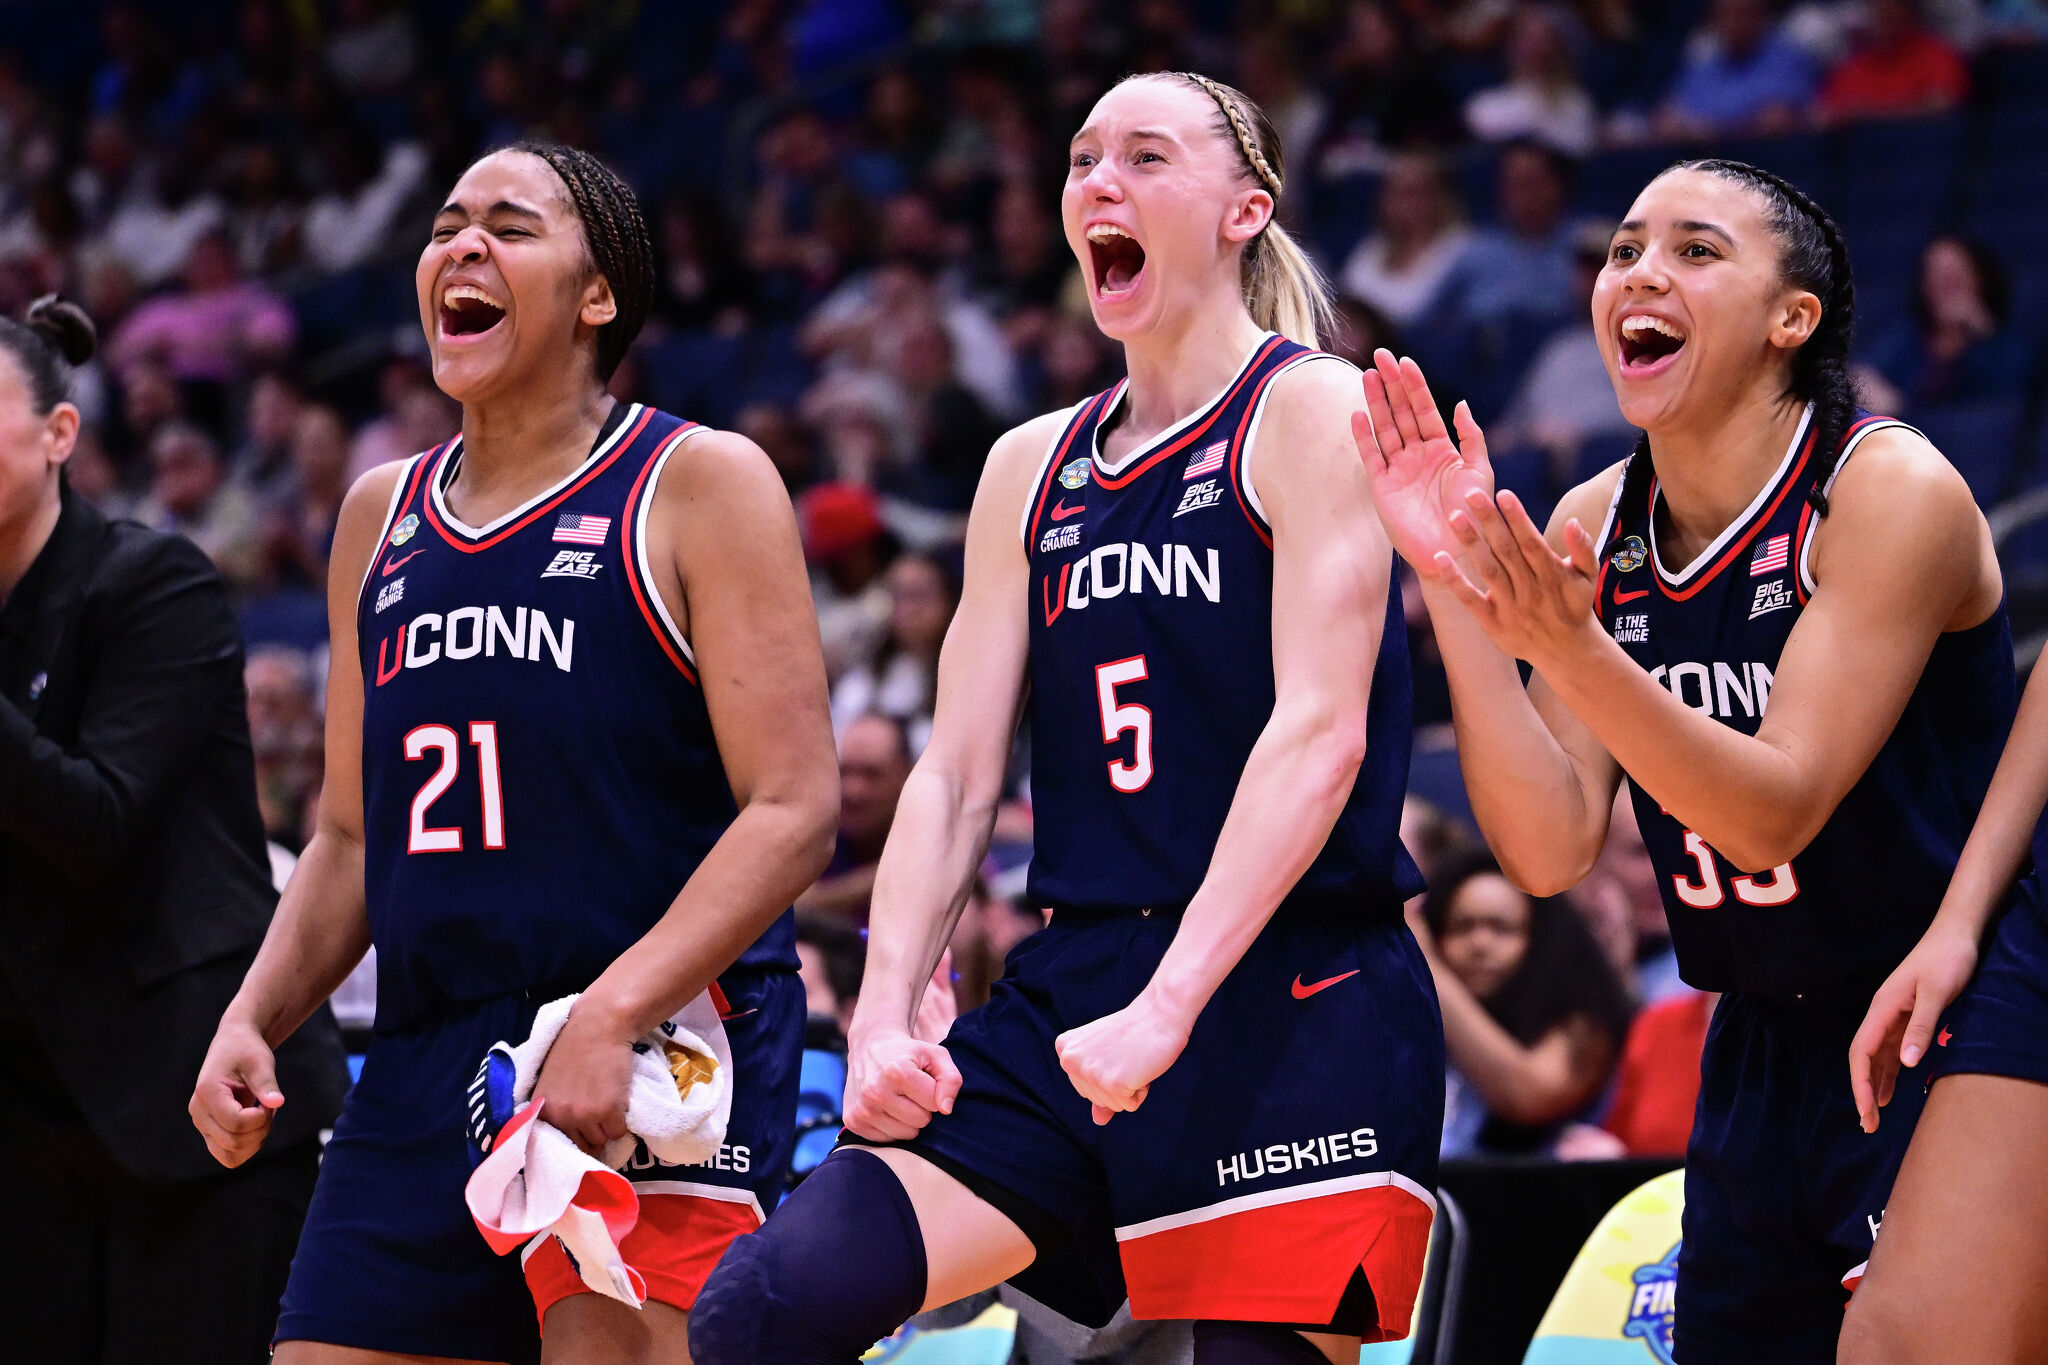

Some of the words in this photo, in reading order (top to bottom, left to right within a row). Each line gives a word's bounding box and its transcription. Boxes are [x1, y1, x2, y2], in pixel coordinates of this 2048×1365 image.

[1177, 488, 1224, 510] EAST
[1183, 479, 1217, 499] BIG
[1044, 527, 1061, 539] BE
[1061, 523, 1084, 535] THE
[1040, 532, 1080, 553] CHANGE
[554, 550, 596, 564] BIG
[546, 562, 603, 576] EAST
[390, 575, 406, 593] THE
[1043, 542, 1221, 627] UCONN
[1755, 579, 1784, 600] BIG
[375, 587, 405, 614] CHANGE
[1751, 590, 1793, 613] EAST
[1625, 614, 1649, 628] THE
[376, 605, 575, 687] UCONN
[1614, 628, 1650, 643] HANGE
[1094, 654, 1154, 793] 5
[403, 721, 506, 855] 21
[1216, 1127, 1378, 1186] HUSKIES
